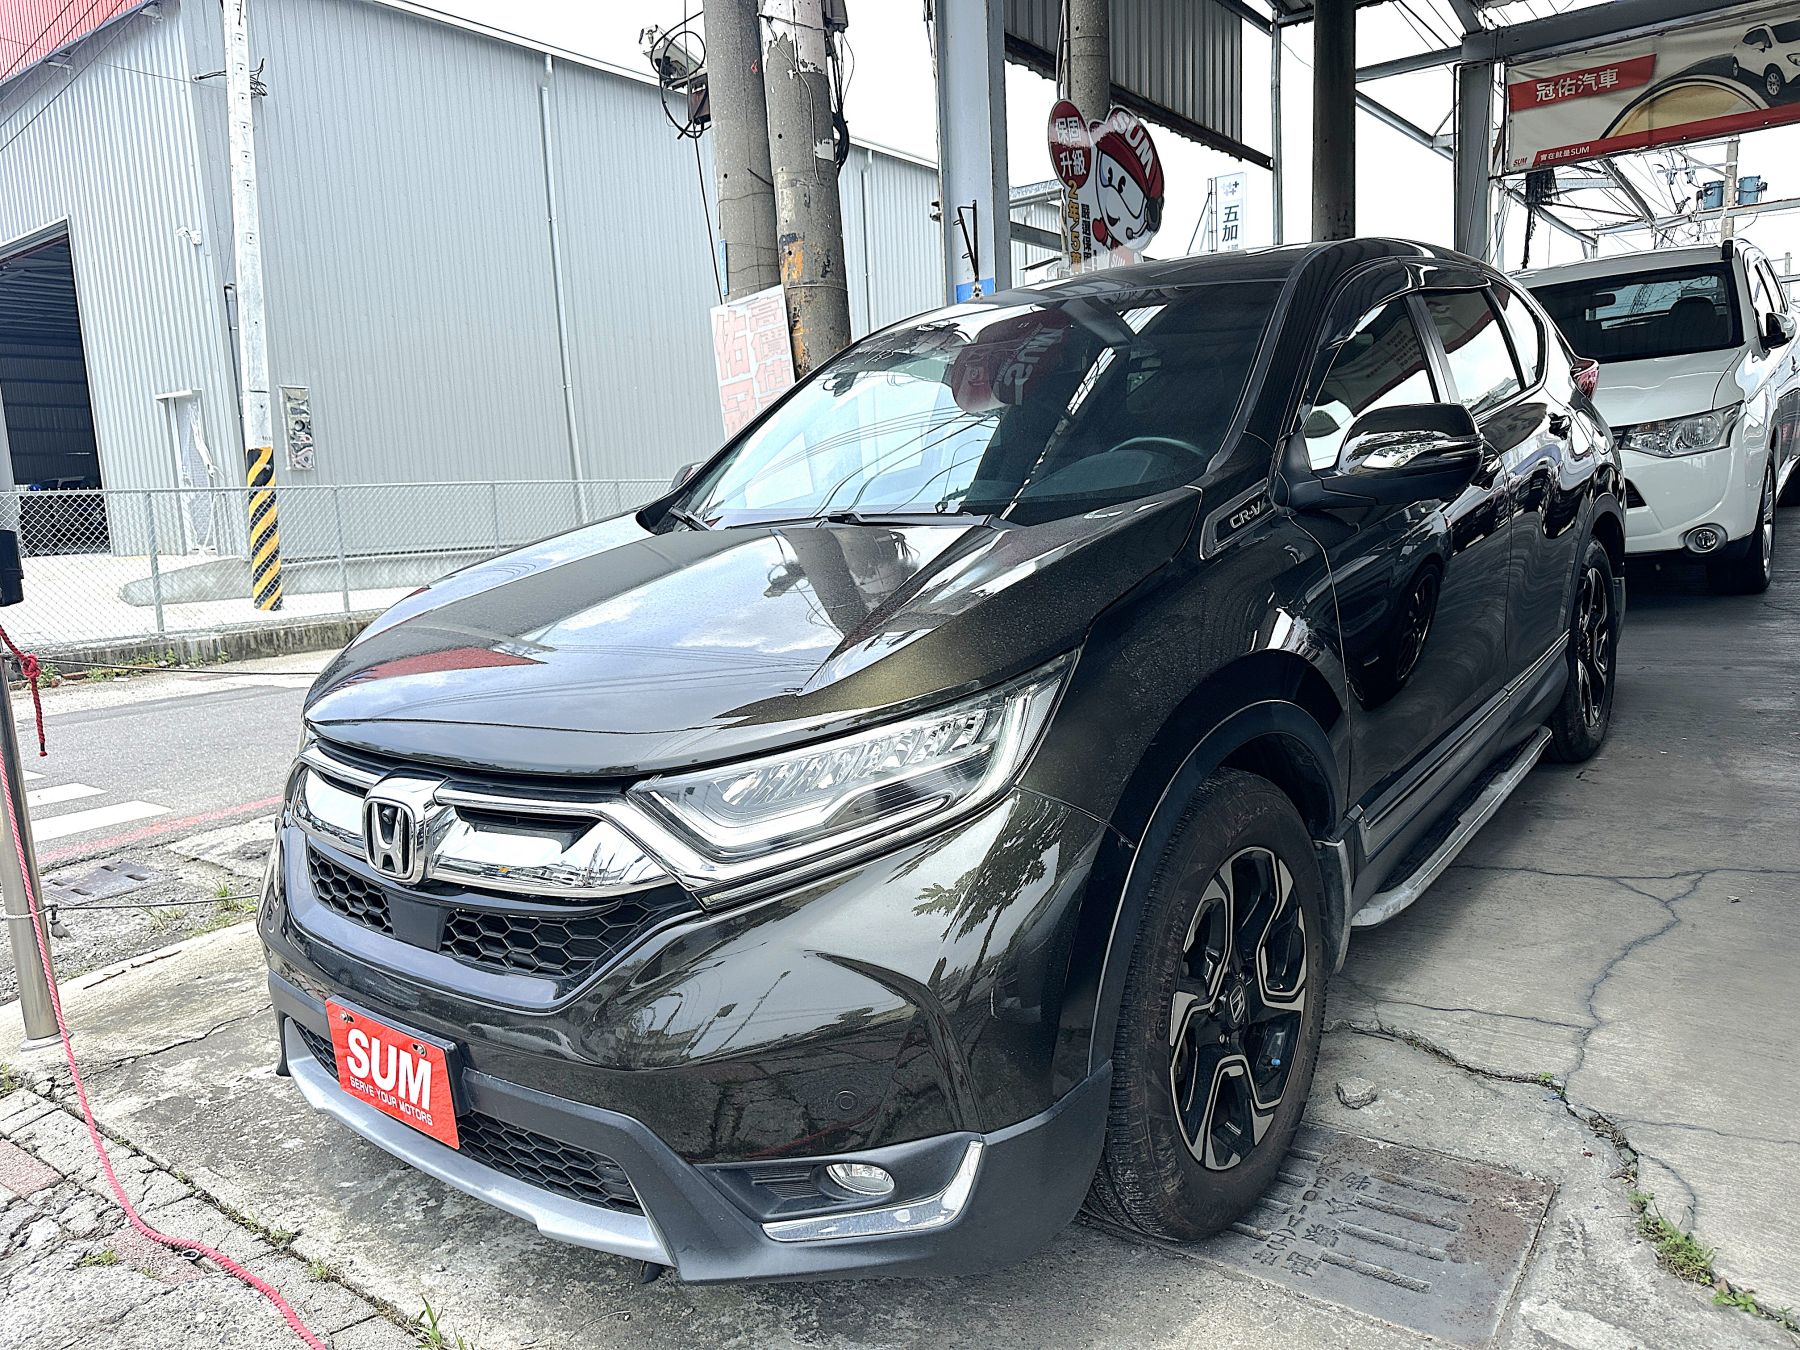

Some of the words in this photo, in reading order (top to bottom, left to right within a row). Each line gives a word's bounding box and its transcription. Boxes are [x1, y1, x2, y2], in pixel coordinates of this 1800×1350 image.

[1536, 68, 1619, 102] 冠佑汽車
[1056, 117, 1081, 143] 保固
[1113, 111, 1154, 178] SUM
[1060, 150, 1086, 177] 升級
[1230, 501, 1260, 528] CR-V
[346, 1028, 432, 1111] SUM
[350, 1076, 375, 1098] SERVE
[377, 1088, 397, 1108] YOUR
[399, 1100, 433, 1126] MOTORS
